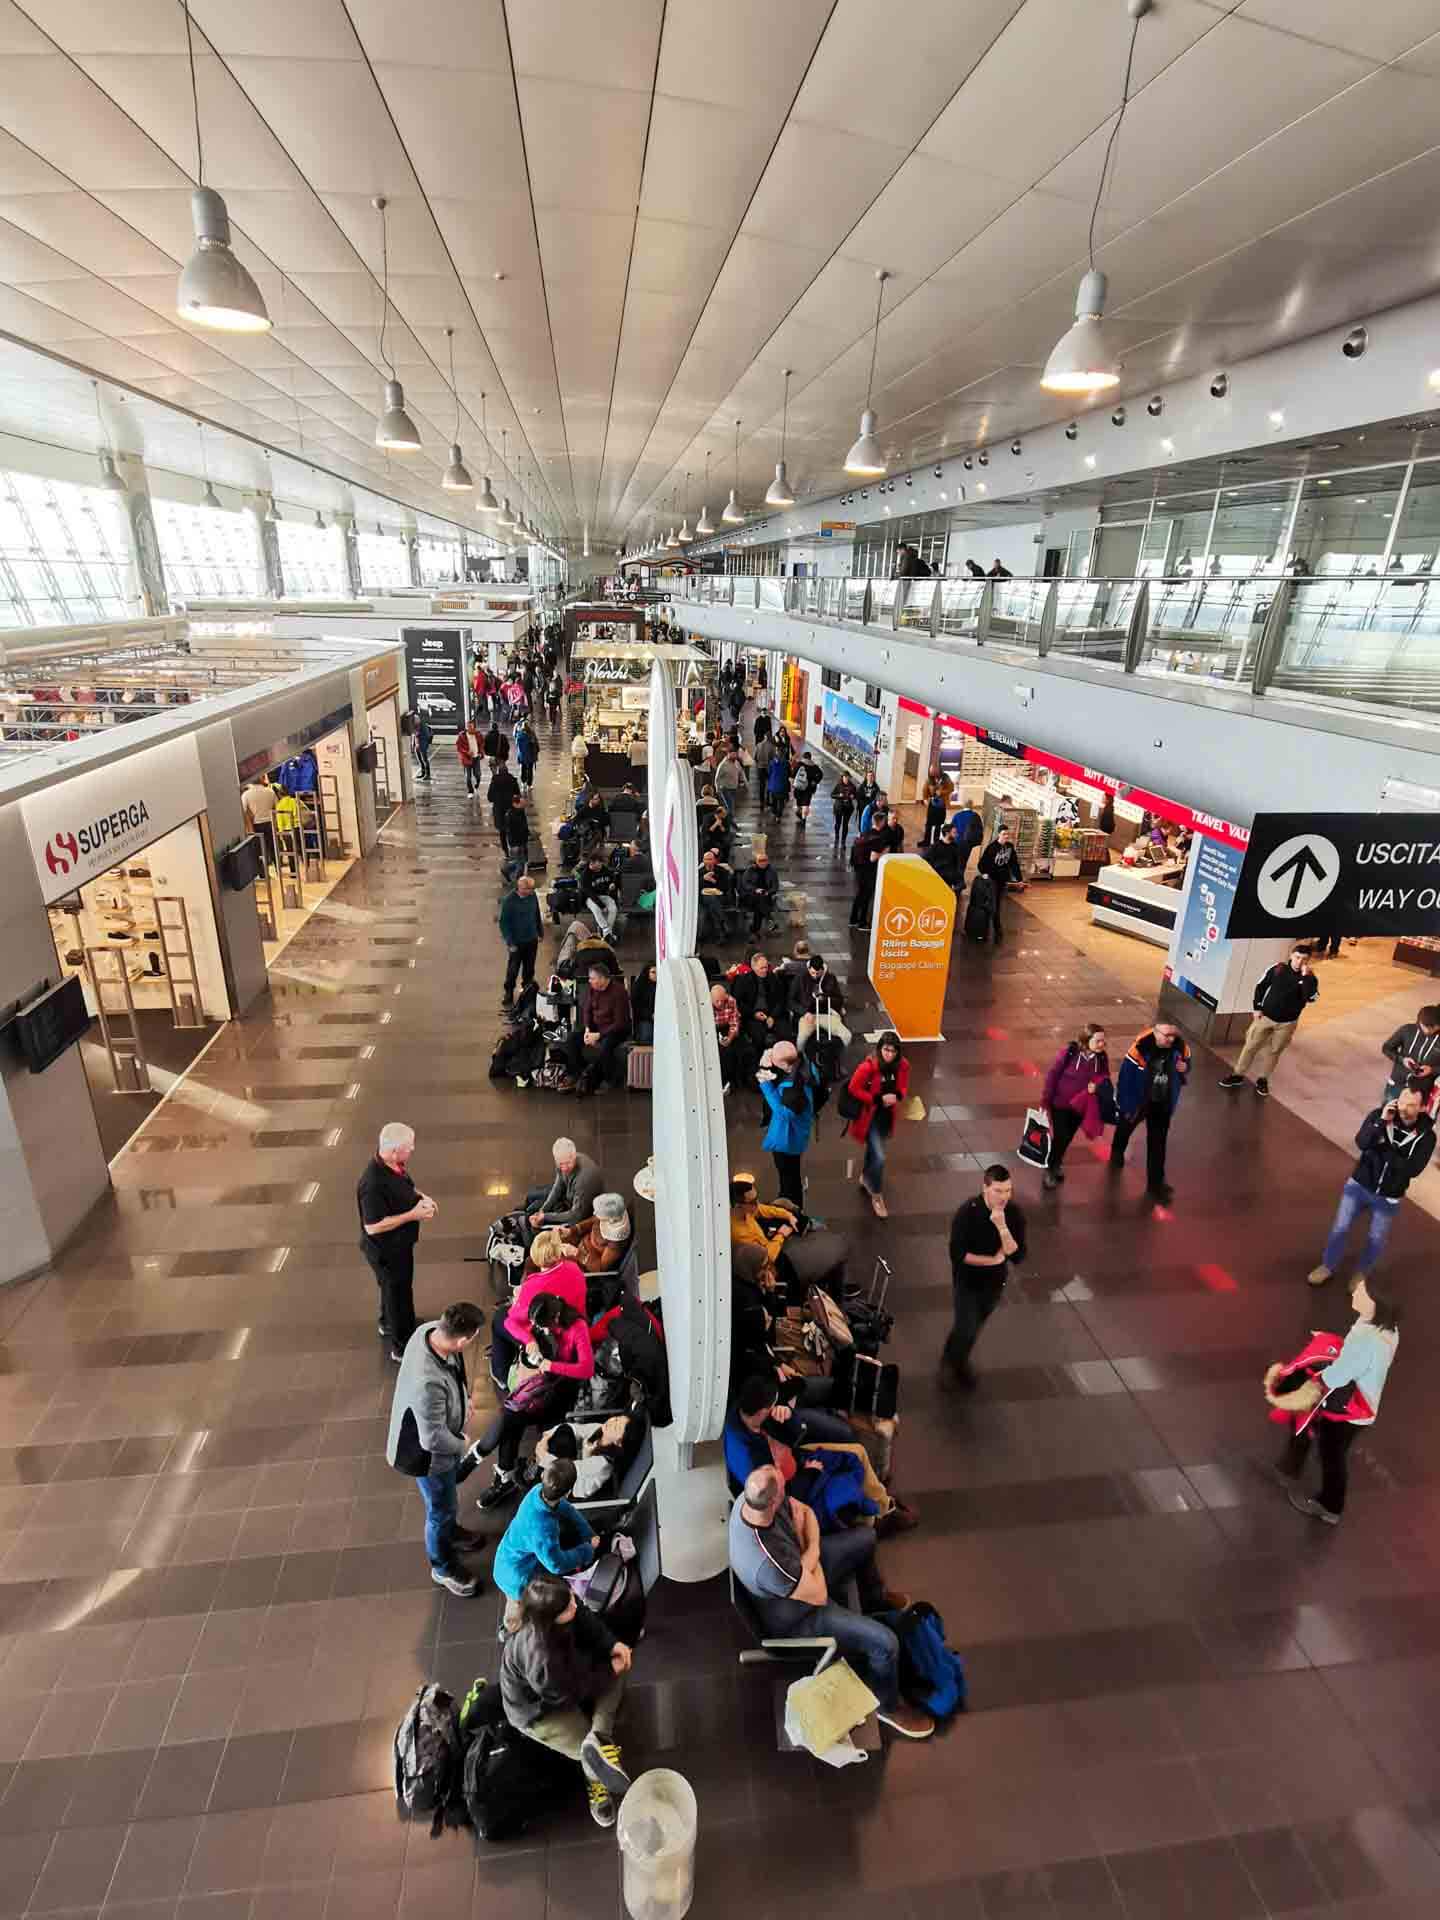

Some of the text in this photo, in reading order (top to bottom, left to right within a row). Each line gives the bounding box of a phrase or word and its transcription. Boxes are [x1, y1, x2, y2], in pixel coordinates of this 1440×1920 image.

[422, 638, 444, 649] Jeep
[584, 660, 630, 683] Venchi
[78, 799, 150, 855] SUPERGA
[1191, 809, 1225, 833] TRAVEL
[1359, 888, 1415, 909] WAY
